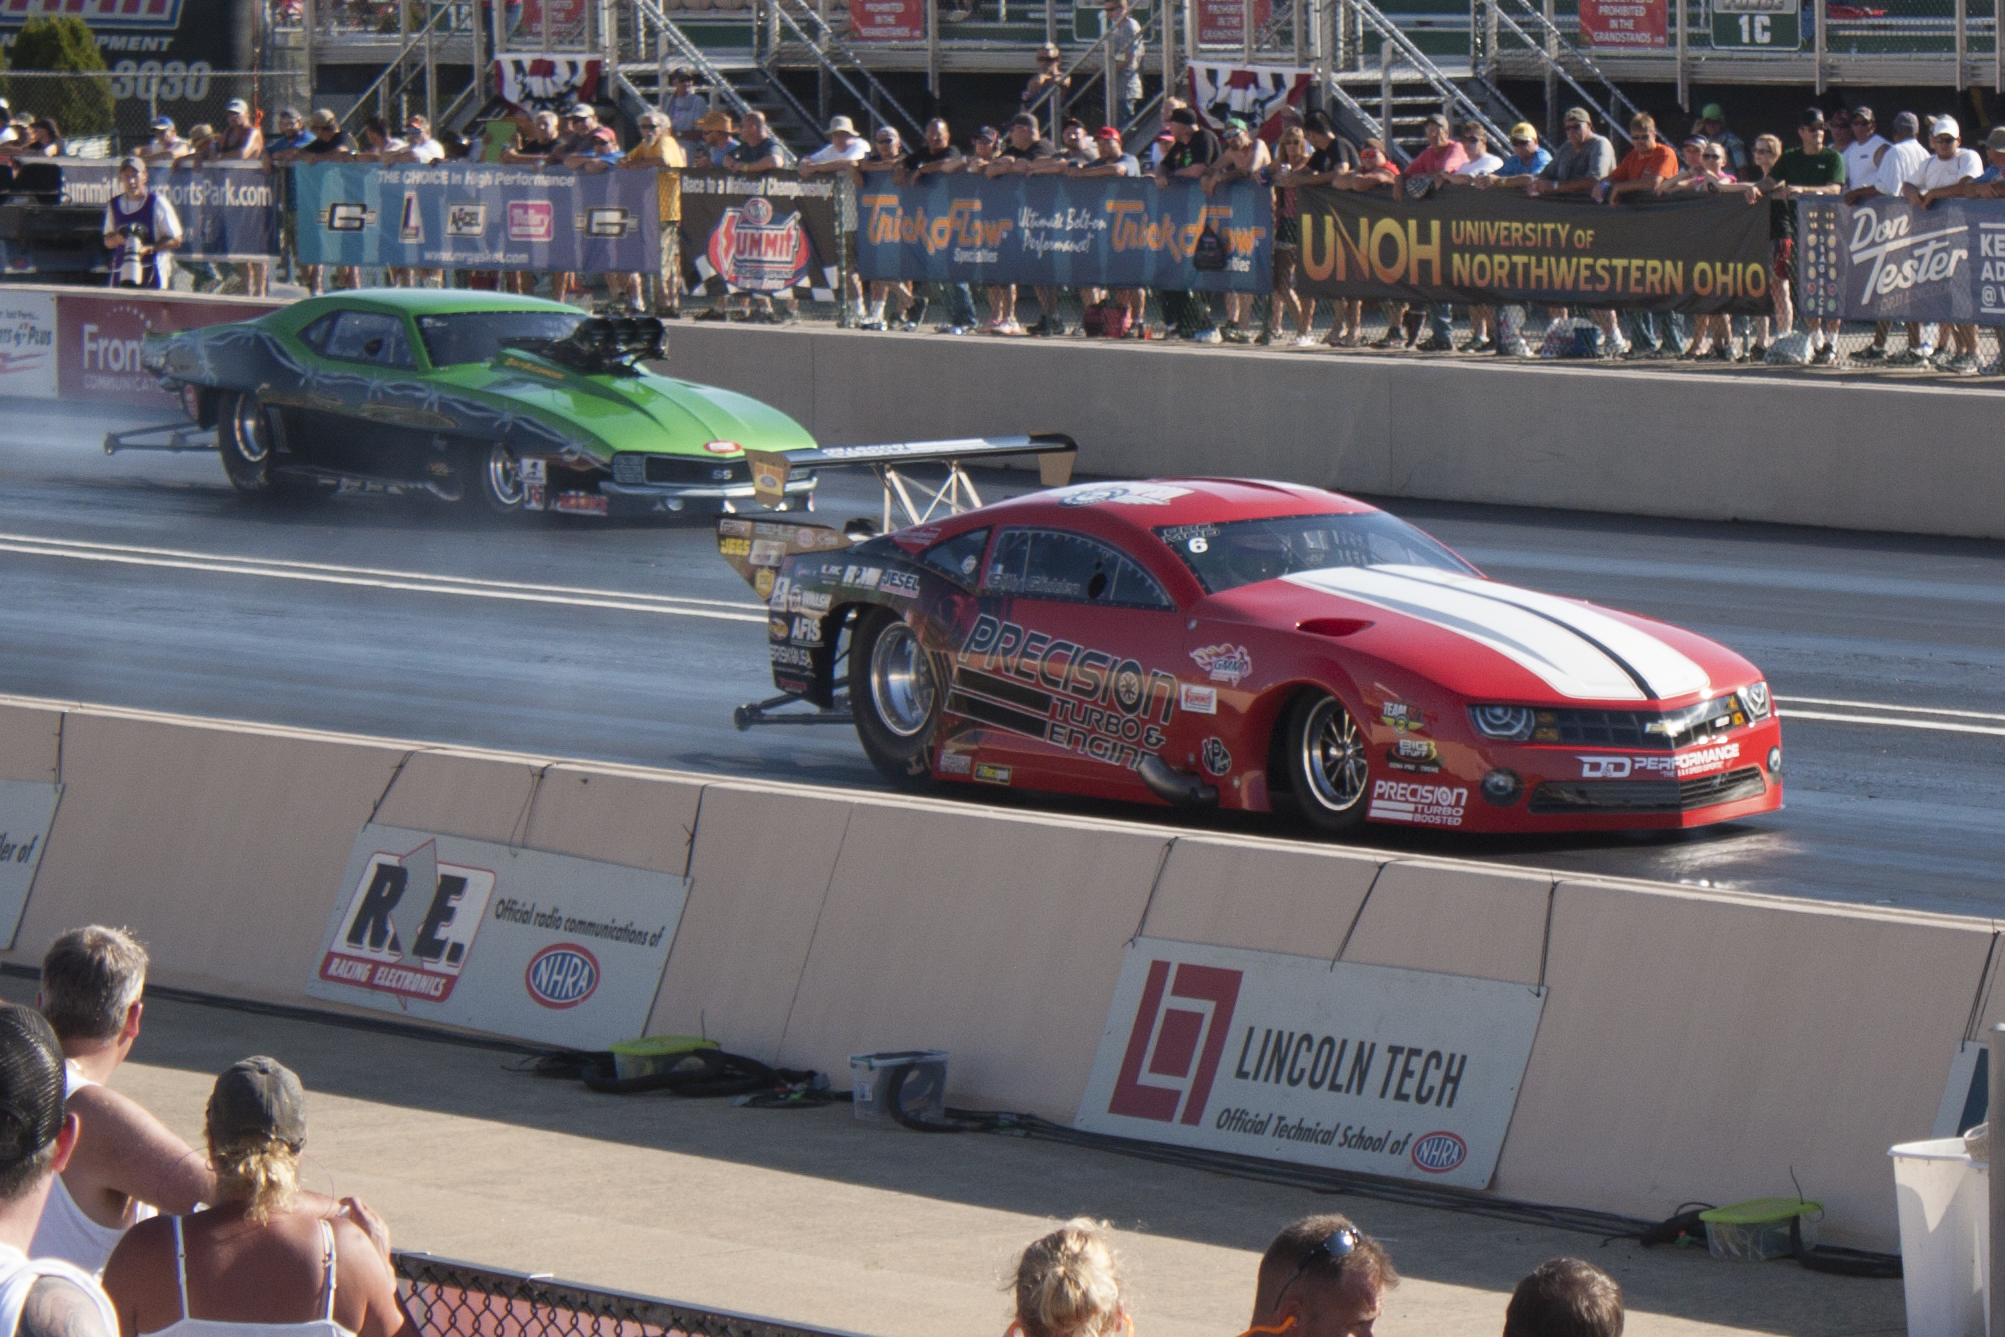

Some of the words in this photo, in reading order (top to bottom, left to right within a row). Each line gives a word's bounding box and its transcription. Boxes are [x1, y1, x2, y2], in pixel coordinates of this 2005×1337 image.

[1598, 5, 1646, 16] PROHIBITED
[1609, 18, 1618, 29] IN
[1619, 18, 1635, 29] THE
[1593, 31, 1651, 43] GRANDSTANDS
[1738, 15, 1771, 43] 1C
[377, 170, 399, 184] THE
[401, 171, 449, 185] CHOICE
[495, 173, 575, 188] Performance
[681, 175, 706, 194] Race
[726, 175, 766, 195] National
[1301, 203, 1442, 286] UNOH
[1451, 219, 1570, 249] UNIVERSITY
[1574, 229, 1595, 250] OF
[1849, 207, 1911, 252] Don
[1452, 253, 1684, 296] NORTHWESTERN
[1693, 259, 1766, 297] OHIO
[1852, 225, 1969, 306] Tester
[1188, 537, 1208, 553] 6
[883, 569, 920, 592] JESEL
[958, 613, 1178, 725] PRECISION
[1054, 699, 1141, 742] TURBO
[1144, 726, 1166, 747] &
[1632, 743, 1740, 770] PERFORMANCE
[1373, 780, 1468, 807] PRECISION
[1412, 814, 1462, 826] BOOSTED
[1413, 803, 1464, 817] TURBO
[17, 834, 38, 863] of
[494, 898, 533, 927] Official
[533, 907, 561, 931] radio
[563, 917, 648, 946] communications
[648, 926, 666, 948] of
[327, 957, 373, 984] RACING
[375, 966, 447, 997] ELECTRONICS
[531, 955, 596, 1000] NHRA
[1234, 1026, 1375, 1096] LINCOLN
[1378, 1045, 1467, 1108] TECH
[1216, 1107, 1270, 1136] Official
[1271, 1115, 1336, 1147] Technical
[1338, 1125, 1384, 1153] School
[1387, 1132, 1413, 1157] of
[1416, 1138, 1463, 1170] NHRA
